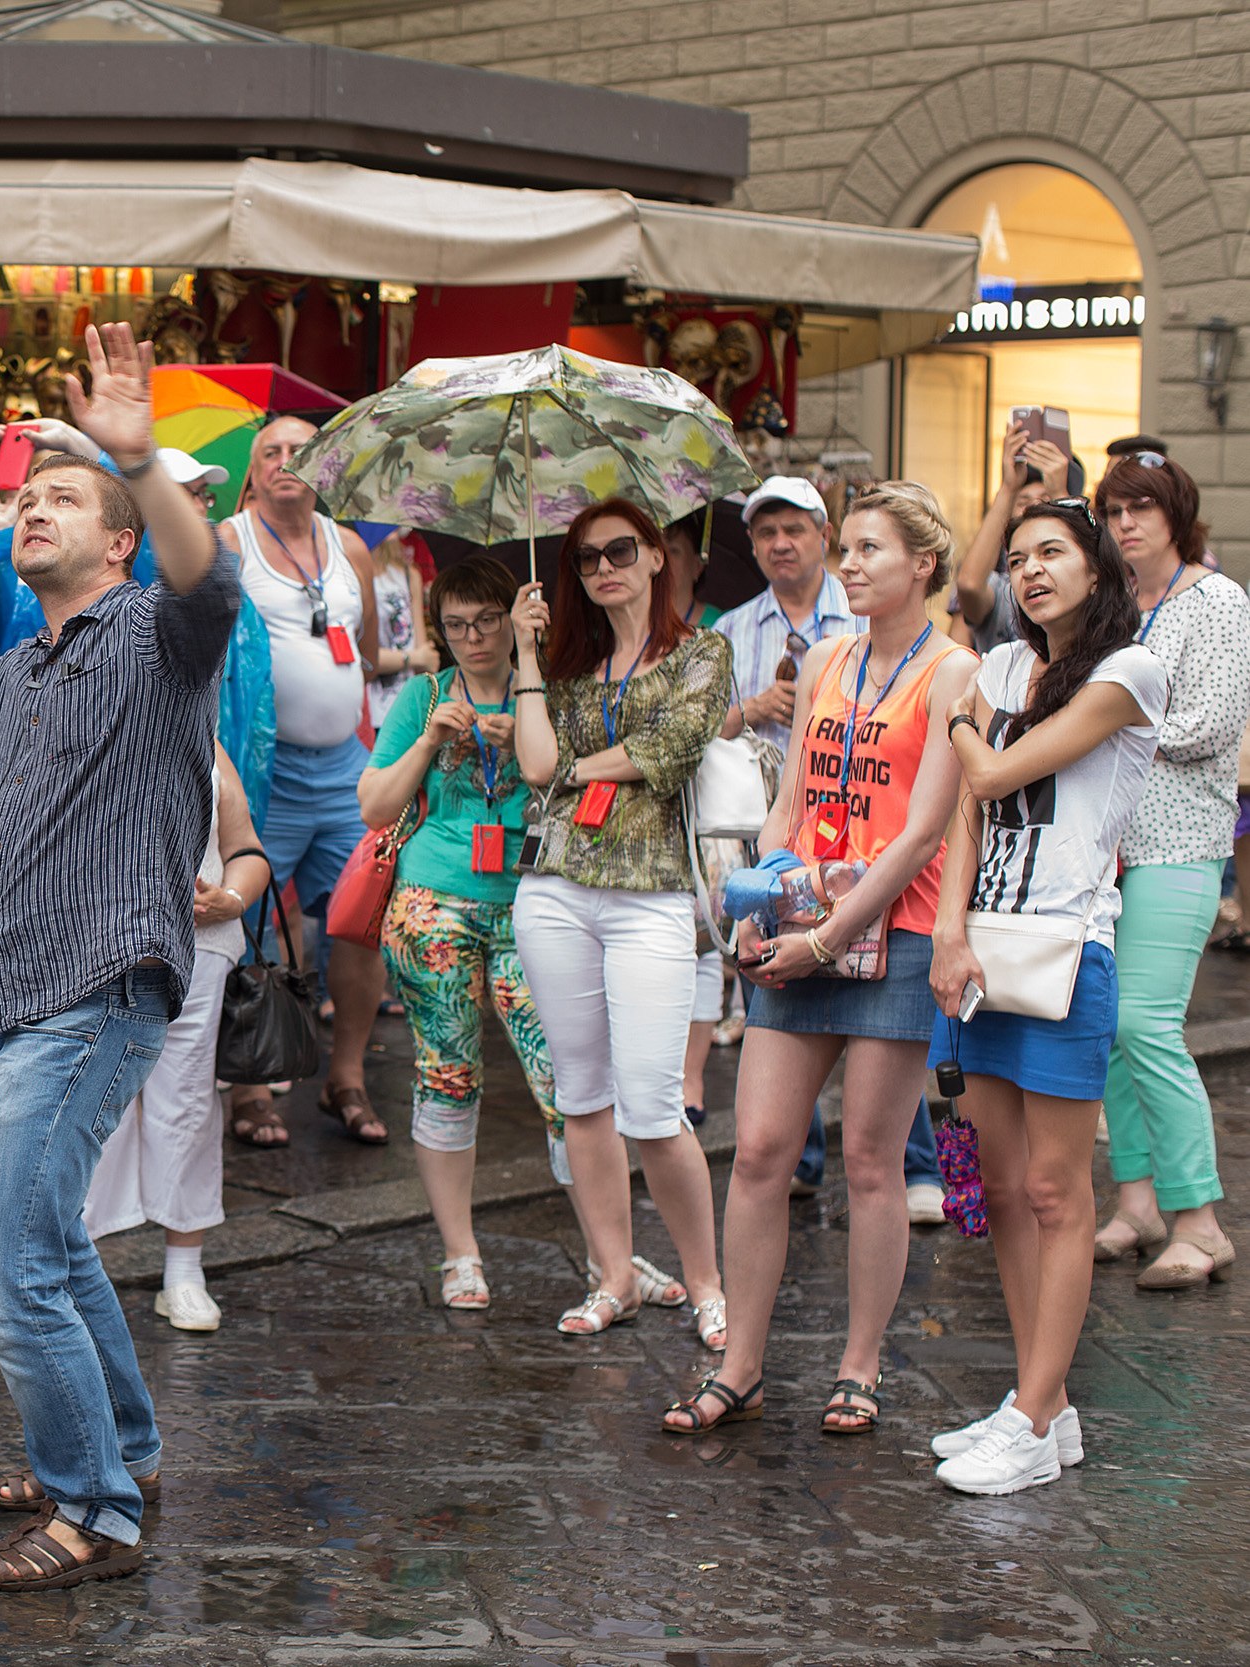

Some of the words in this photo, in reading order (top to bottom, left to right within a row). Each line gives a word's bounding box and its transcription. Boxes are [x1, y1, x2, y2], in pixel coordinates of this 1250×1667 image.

[948, 295, 1145, 333] imissimi
[806, 715, 815, 738] I
[810, 751, 891, 786] MONING
